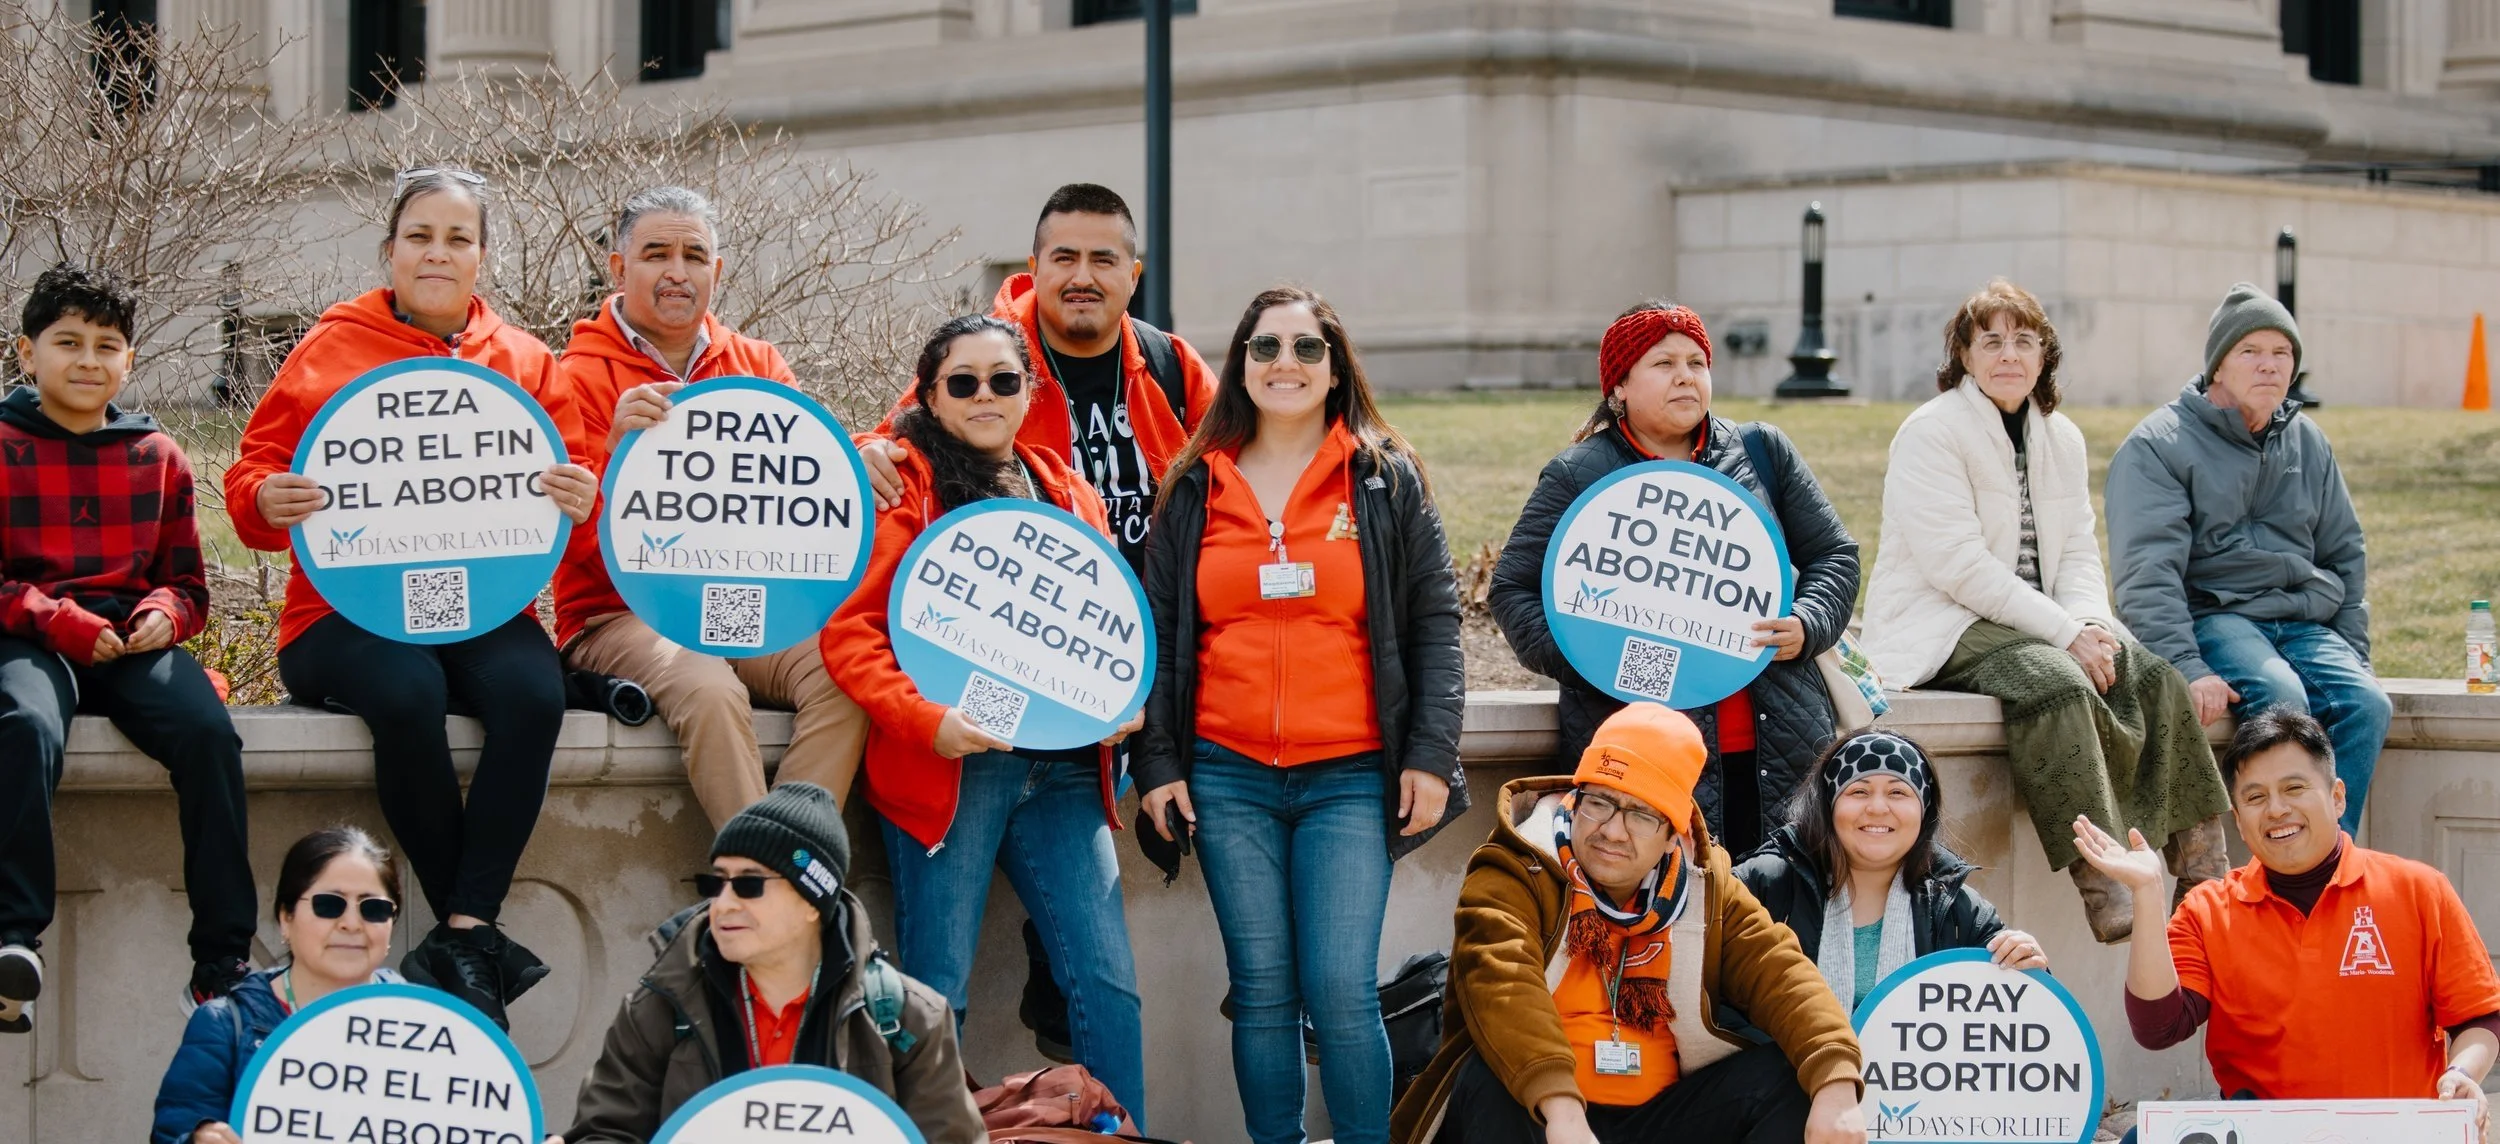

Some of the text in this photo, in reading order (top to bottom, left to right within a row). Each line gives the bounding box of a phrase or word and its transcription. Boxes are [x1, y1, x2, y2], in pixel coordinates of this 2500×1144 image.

[377, 388, 479, 419] REZA
[686, 409, 799, 444] PRAY
[323, 428, 533, 467] POR EL FIN
[657, 450, 821, 486] TO END
[620, 490, 851, 529] ABORTION
[1636, 482, 1742, 532] PRAY
[358, 531, 408, 556] DÍAS
[413, 533, 457, 553] POR
[460, 531, 487, 549] LA
[488, 527, 545, 546] VIDA
[627, 544, 840, 575] 40 DAYS FOR LIFE
[1012, 520, 1099, 586] REZA
[1607, 511, 1751, 572] TO END
[950, 531, 1136, 644] POR EL FIN
[1564, 542, 1772, 617] ABORTION
[917, 558, 1136, 682] DEL ABORTO
[1563, 590, 1752, 655] 40 DAYS FOR LIFE
[941, 627, 988, 662] DÍAS
[990, 648, 1030, 679] POR
[1032, 669, 1057, 692] LA
[1060, 680, 1109, 714] VIDA
[1918, 983, 2028, 1013] PRAY
[346, 1016, 457, 1056] REZA
[1891, 1022, 2051, 1053] TO END
[279, 1058, 511, 1111] POR EL FIN
[1864, 1061, 2080, 1093] ABORTION
[254, 1105, 335, 1141] DEL
[744, 1100, 855, 1136] REZA
[1866, 1112, 2071, 1139] 40 DAYS FOR LIFE
